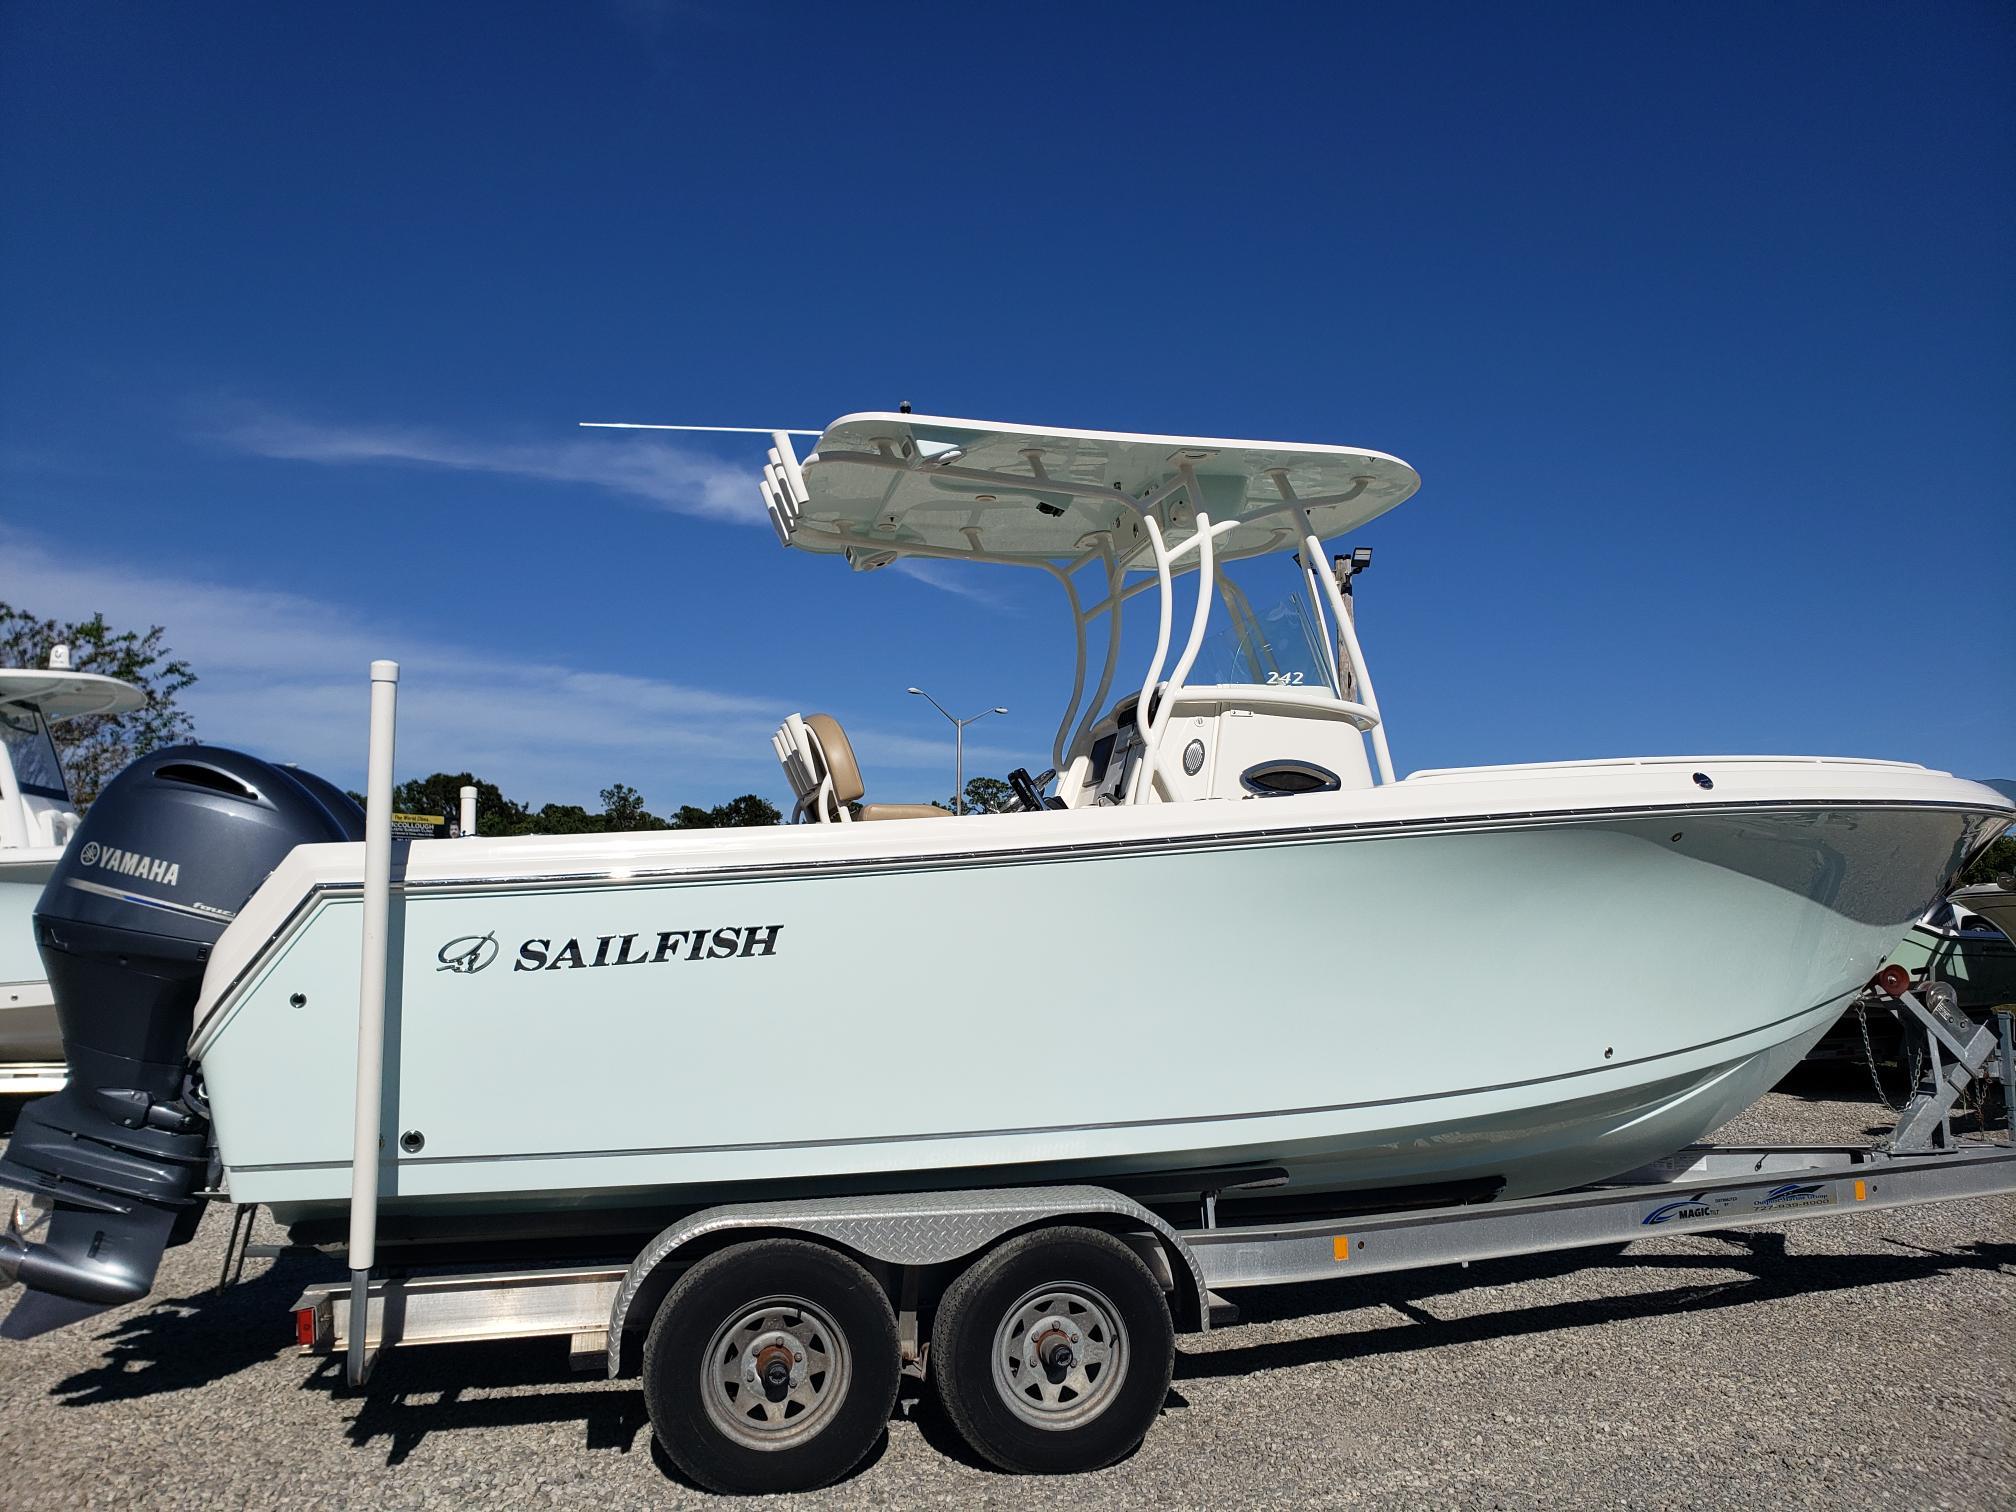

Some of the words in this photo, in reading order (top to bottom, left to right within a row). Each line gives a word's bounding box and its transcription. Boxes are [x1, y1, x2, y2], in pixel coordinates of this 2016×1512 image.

[1266, 671, 1304, 684] 242
[99, 846, 180, 886] YAMAHA
[513, 924, 785, 971] SAILFISH
[1679, 1207, 1710, 1219] MAGIC
